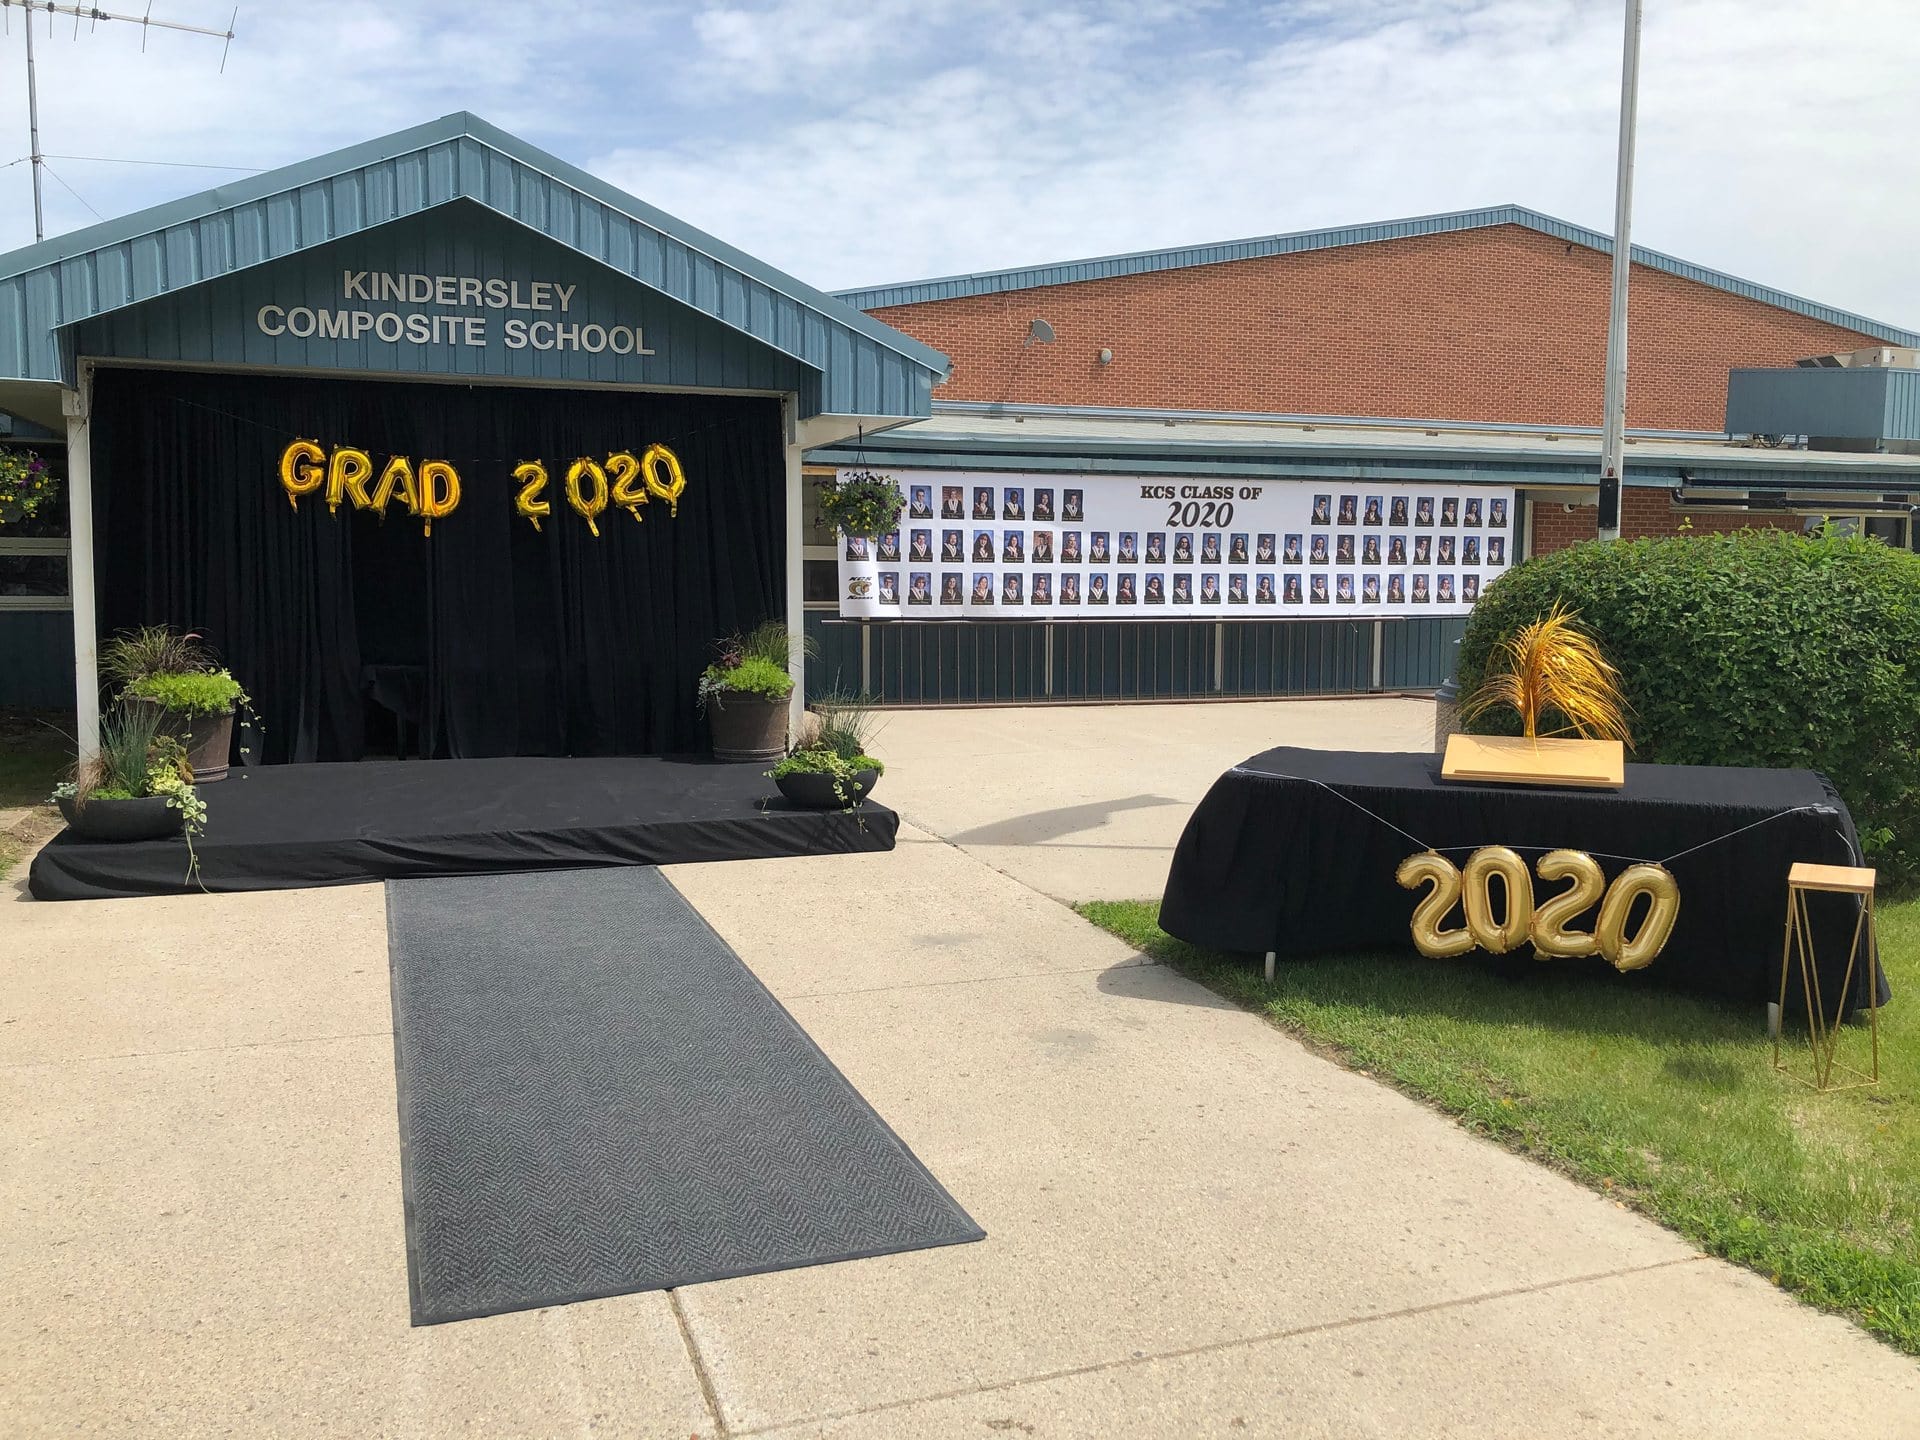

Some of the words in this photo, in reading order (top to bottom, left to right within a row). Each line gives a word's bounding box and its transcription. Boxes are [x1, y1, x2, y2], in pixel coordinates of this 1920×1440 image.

[343, 270, 577, 312] KINDERSLEY
[257, 305, 487, 347] COMPOSITE
[504, 318, 656, 356] SCHOOL
[278, 437, 463, 520] GRAD
[510, 442, 688, 521] 2020
[1140, 485, 1176, 499] KCS
[1180, 485, 1235, 500] CLASS
[1238, 486, 1263, 500] OF
[1165, 501, 1234, 528] 2020
[1395, 844, 1681, 973] 2020
